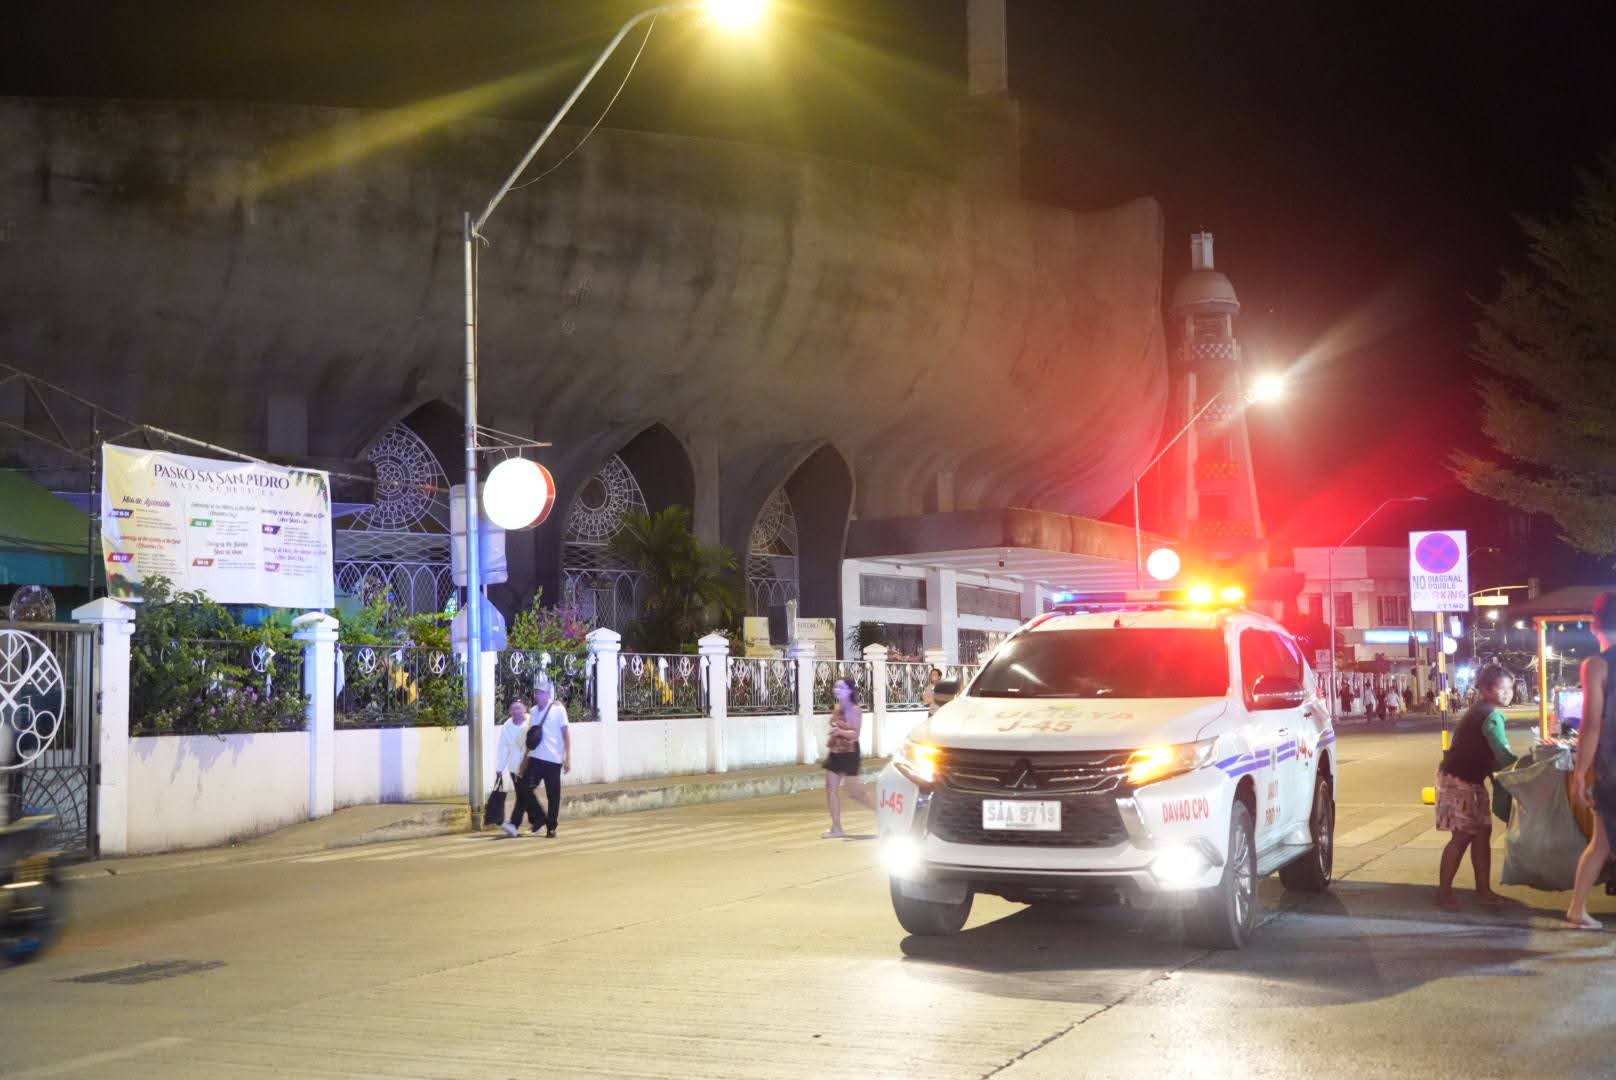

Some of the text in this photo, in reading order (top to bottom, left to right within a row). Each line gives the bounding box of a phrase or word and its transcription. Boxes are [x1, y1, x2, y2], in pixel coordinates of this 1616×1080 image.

[154, 464, 195, 481] PASKO
[197, 470, 213, 483] SA
[216, 471, 243, 485] SAN
[1412, 575, 1463, 590] NO DIAGONAL
[997, 719, 1074, 733] J-45
[879, 787, 905, 816] J-45
[1161, 797, 1209, 824] DAVAO CPO
[987, 806, 1014, 823] SAA
